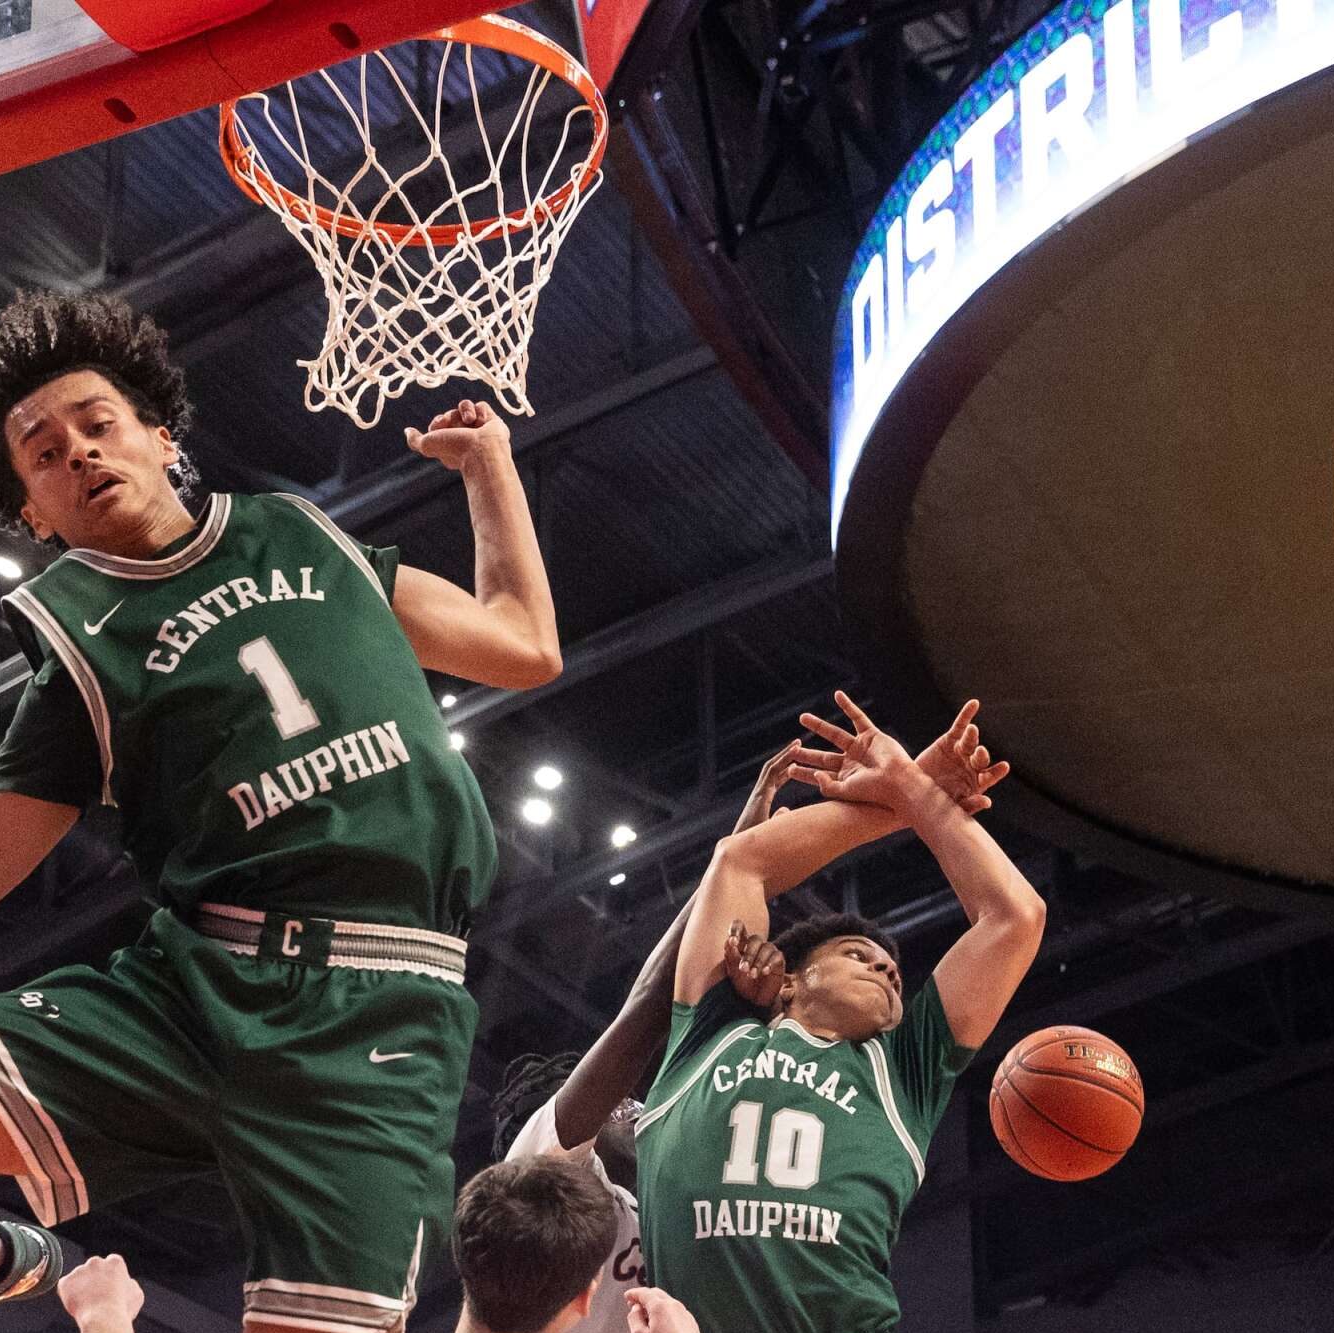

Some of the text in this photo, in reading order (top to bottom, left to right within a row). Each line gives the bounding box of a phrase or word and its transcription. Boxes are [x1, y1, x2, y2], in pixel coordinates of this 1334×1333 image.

[145, 566, 325, 674] CENTRAL
[237, 635, 322, 741] 1
[227, 720, 411, 832] DAUPHIN
[281, 919, 305, 957] C
[713, 1048, 859, 1115] CENTRAL
[722, 1101, 825, 1191] 10
[694, 1198, 843, 1246] DAUPHIN
